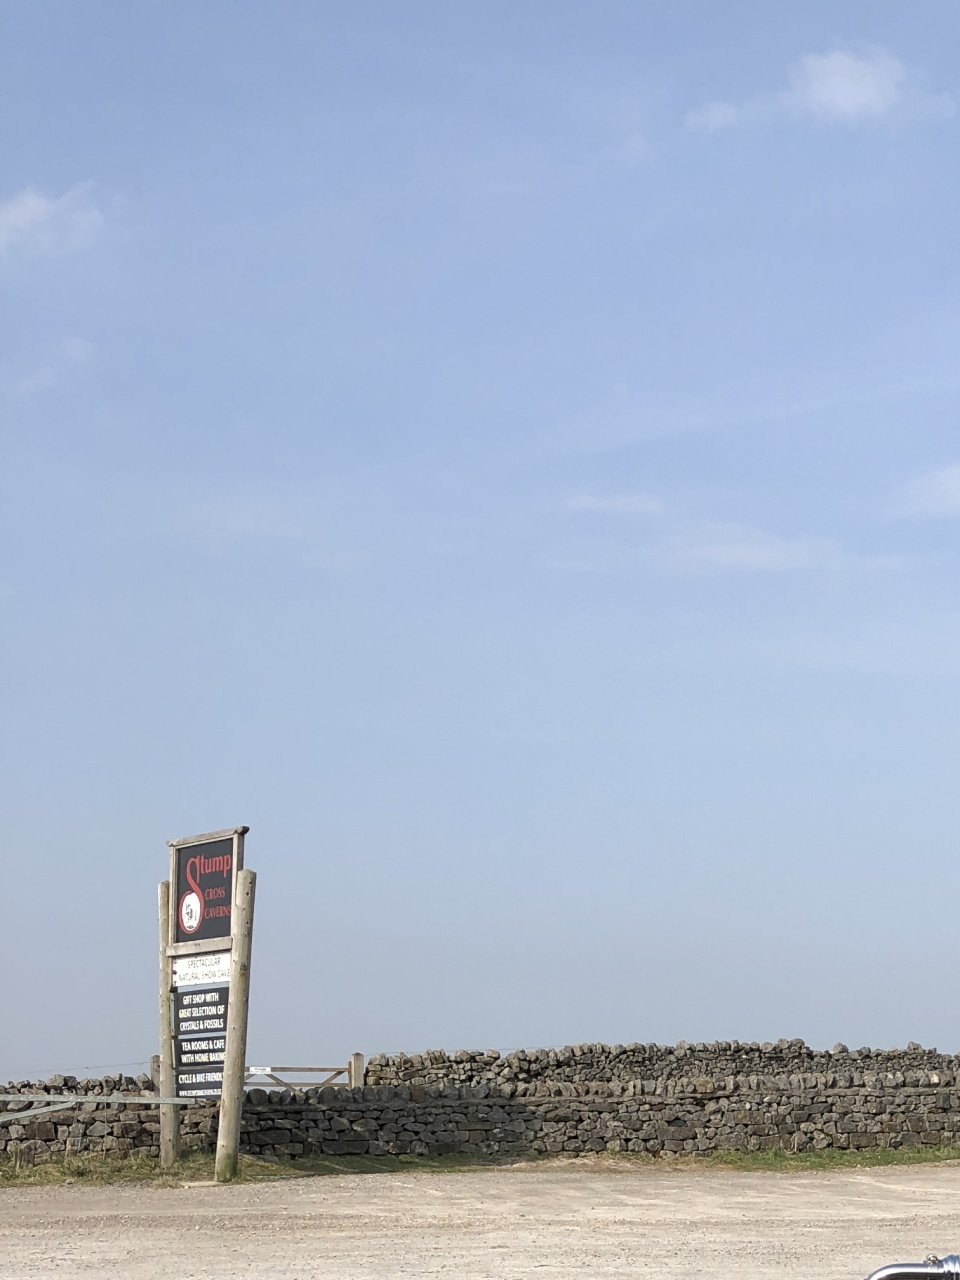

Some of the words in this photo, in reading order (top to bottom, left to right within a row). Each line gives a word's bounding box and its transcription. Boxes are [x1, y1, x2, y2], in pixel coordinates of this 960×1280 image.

[205, 887, 225, 900] CROSS
[183, 996, 192, 1005] GIFT
[193, 994, 205, 1003] SHOP
[205, 992, 218, 1002] WITH
[179, 1009, 191, 1018] GREAT
[192, 1006, 216, 1016] SELECTION
[217, 1005, 225, 1014] OF
[180, 1021, 199, 1031] CRYSTALS
[204, 1019, 223, 1028] FOSSILS
[182, 1042, 191, 1051] TEA
[191, 1041, 208, 1050] ROOMS
[214, 1040, 225, 1049] CAFE
[181, 1054, 194, 1063] WITH
[195, 1053, 209, 1062] HOME
[179, 1074, 192, 1084] CYCLE
[197, 1073, 205, 1082] BIKE
